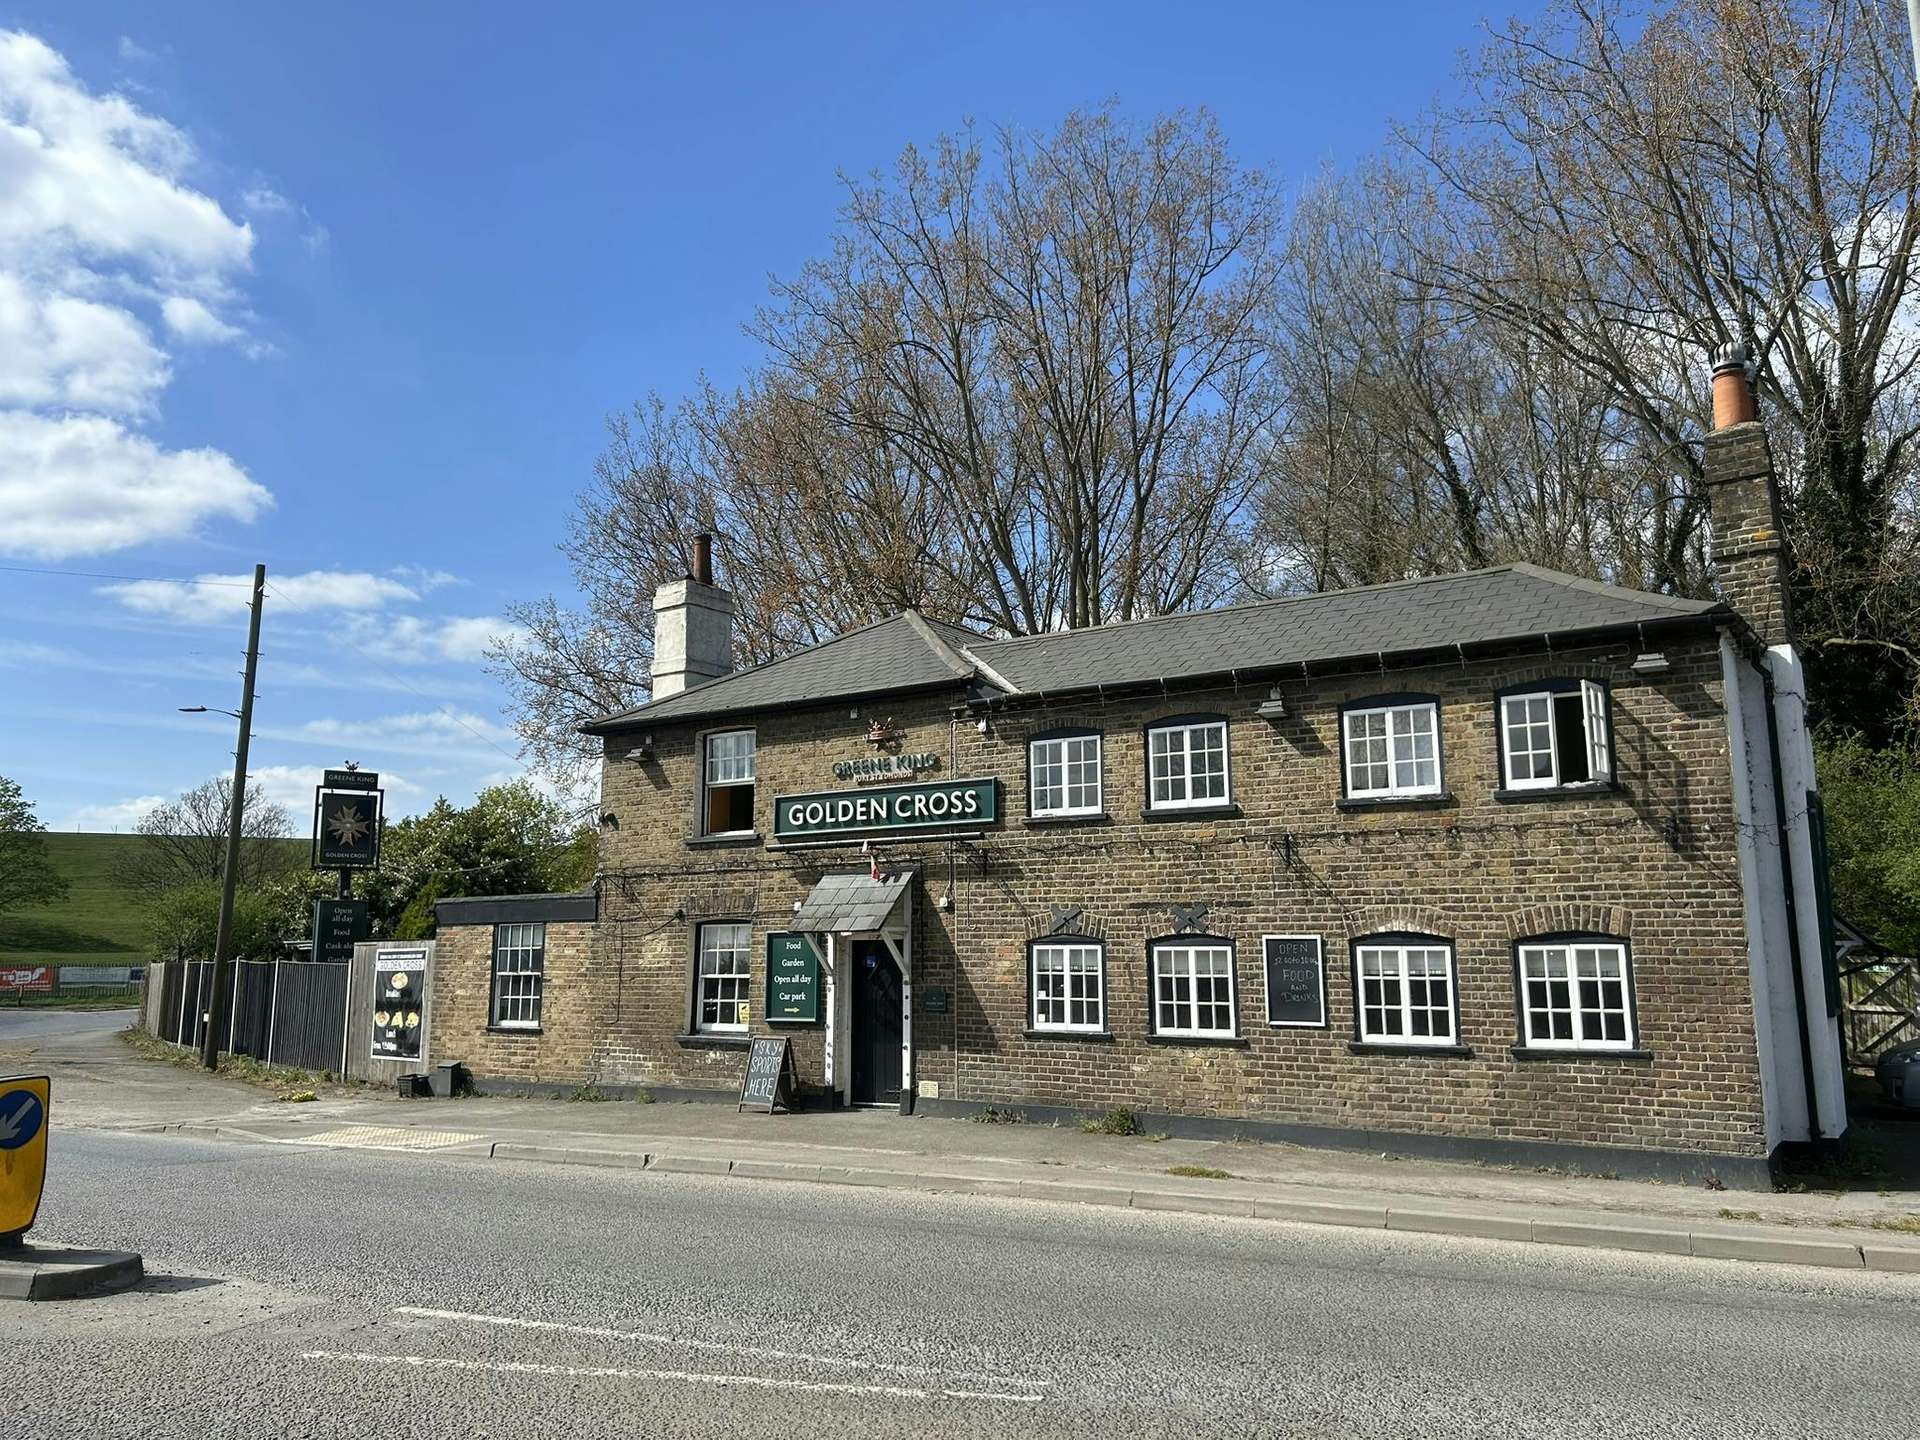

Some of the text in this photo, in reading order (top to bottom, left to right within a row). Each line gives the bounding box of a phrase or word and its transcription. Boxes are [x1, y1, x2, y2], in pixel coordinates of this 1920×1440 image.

[833, 753, 936, 776] GREENE KING
[328, 774, 355, 782] GREENE
[356, 776, 375, 784] KING
[788, 790, 978, 826] GOLDEN CROSS
[334, 907, 353, 916] Open
[341, 915, 353, 923] day
[786, 941, 802, 950] Food
[1279, 942, 1308, 955] OPEN
[782, 958, 805, 967] Garden
[774, 974, 812, 985] Open all day
[1283, 969, 1315, 982] FOOD
[1290, 983, 1309, 992] AND
[779, 992, 806, 1002] Car park
[759, 1040, 780, 1056] SKY
[751, 1056, 782, 1074] SPORTS
[748, 1077, 775, 1098] HERE
